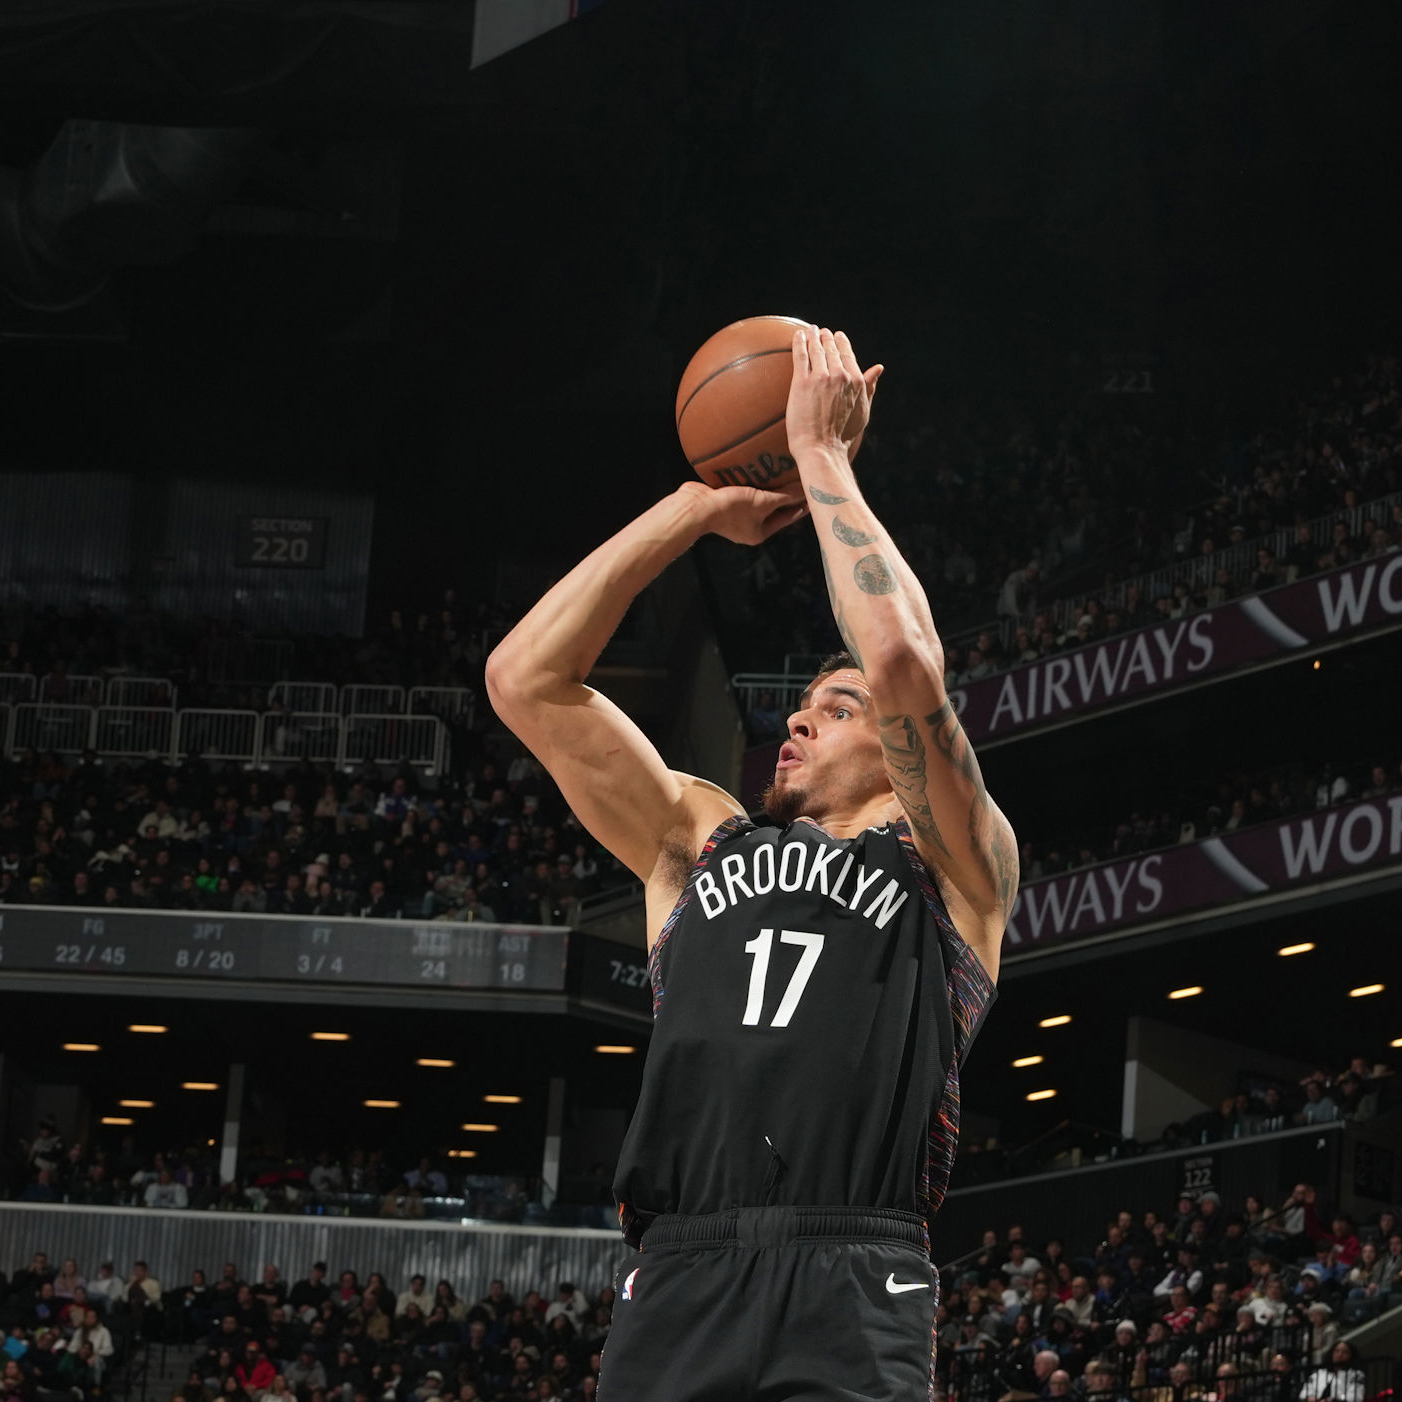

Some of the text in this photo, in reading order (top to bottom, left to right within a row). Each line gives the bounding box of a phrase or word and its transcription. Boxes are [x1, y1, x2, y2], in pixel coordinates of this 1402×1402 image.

[251, 537, 309, 562] 220
[989, 613, 1214, 731] AIRWAYS
[695, 841, 909, 930] BROOKLYN
[1004, 855, 1164, 944] RWAYS
[82, 918, 106, 936] FG
[312, 928, 333, 944] FT
[420, 960, 446, 979] 24
[500, 963, 526, 982] 18
[741, 928, 826, 1028] 17
[1184, 1168, 1211, 1188] 122
